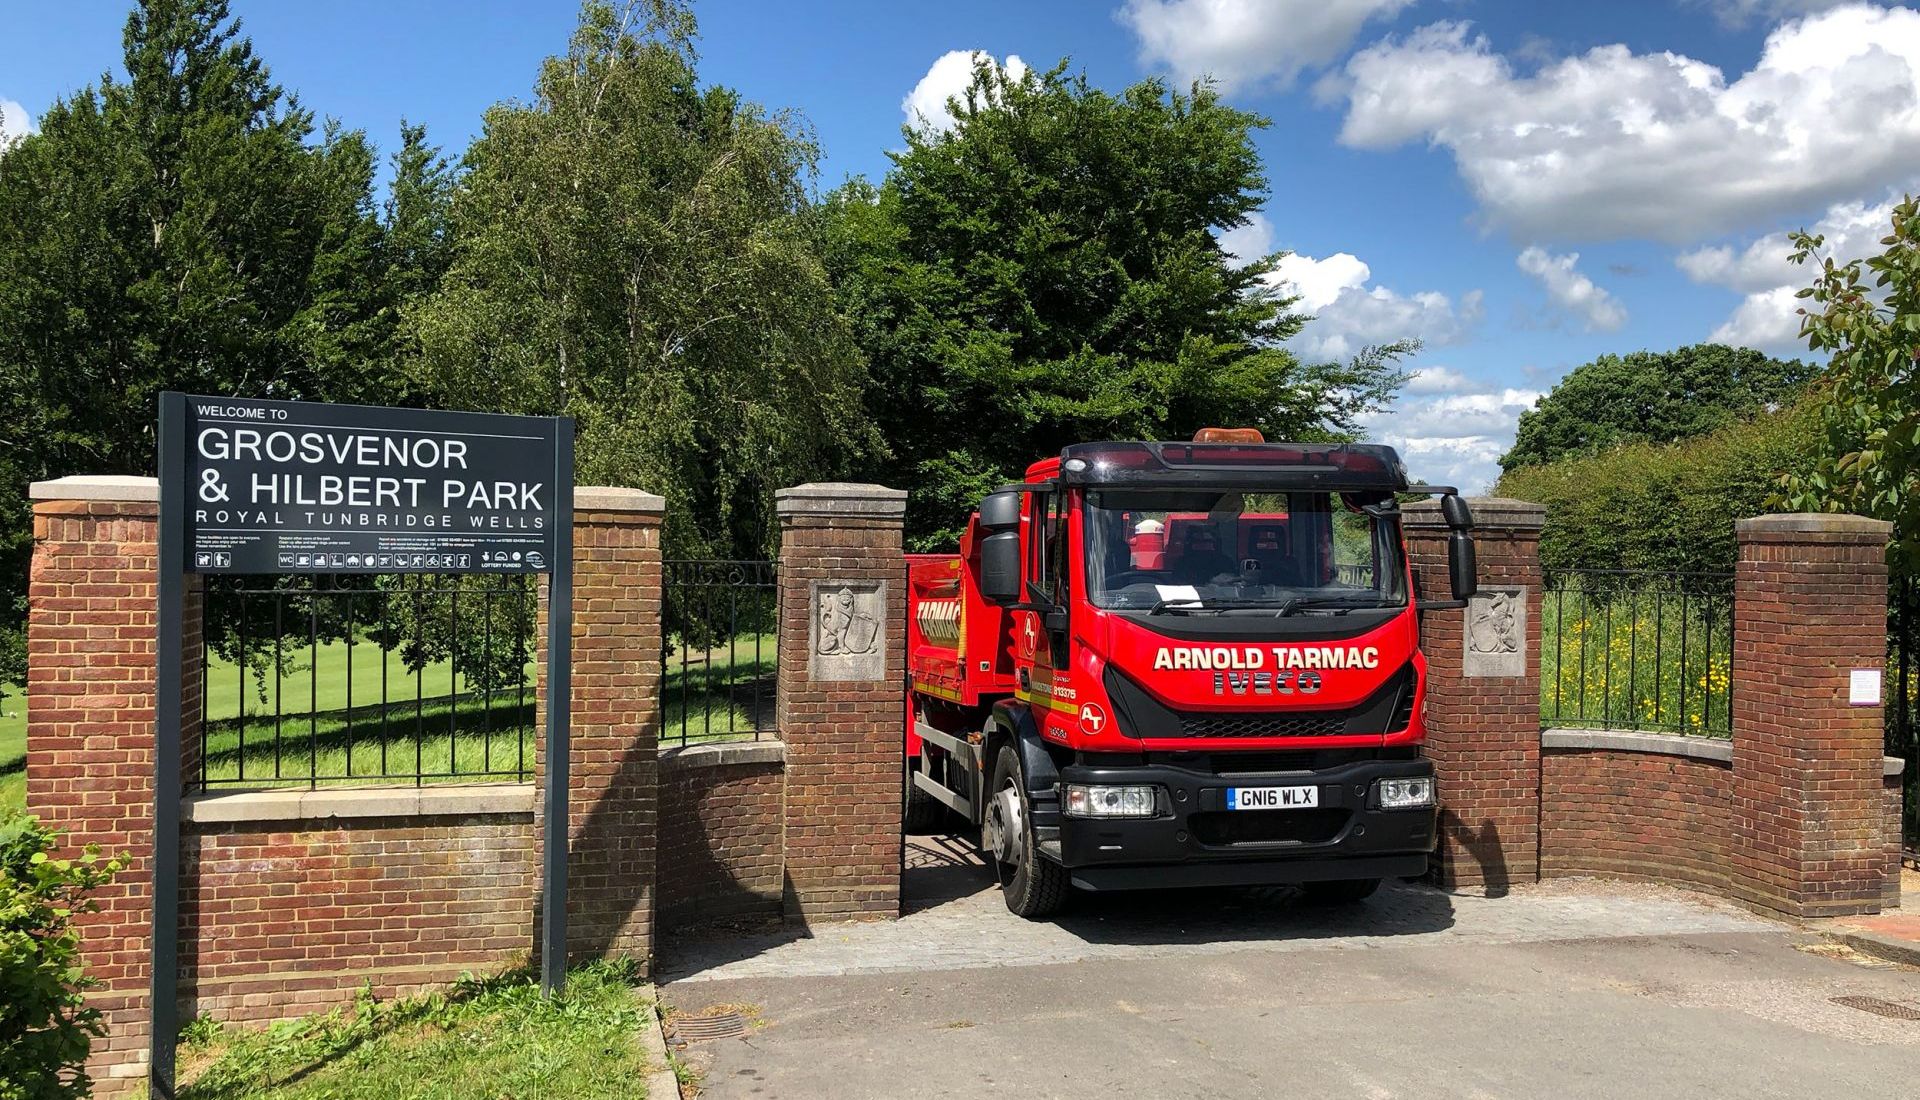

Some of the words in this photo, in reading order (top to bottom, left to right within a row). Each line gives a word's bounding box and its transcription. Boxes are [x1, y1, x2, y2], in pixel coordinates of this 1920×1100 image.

[197, 405, 265, 419] WELCOME
[269, 408, 288, 420] TO
[197, 428, 468, 469] GROSVENOR
[198, 469, 230, 503] &
[251, 473, 426, 508] HILBERT
[443, 480, 544, 511] PARK
[195, 510, 285, 524] ROYAL
[305, 512, 452, 527] TUNBRIDGE
[470, 515, 544, 528] WELLS
[1154, 647, 1264, 670] ARNOLD
[1272, 646, 1379, 670] TARMAC
[1213, 671, 1323, 696] IVECO
[1242, 790, 1277, 806] GN16
[1282, 789, 1312, 804] WLX
